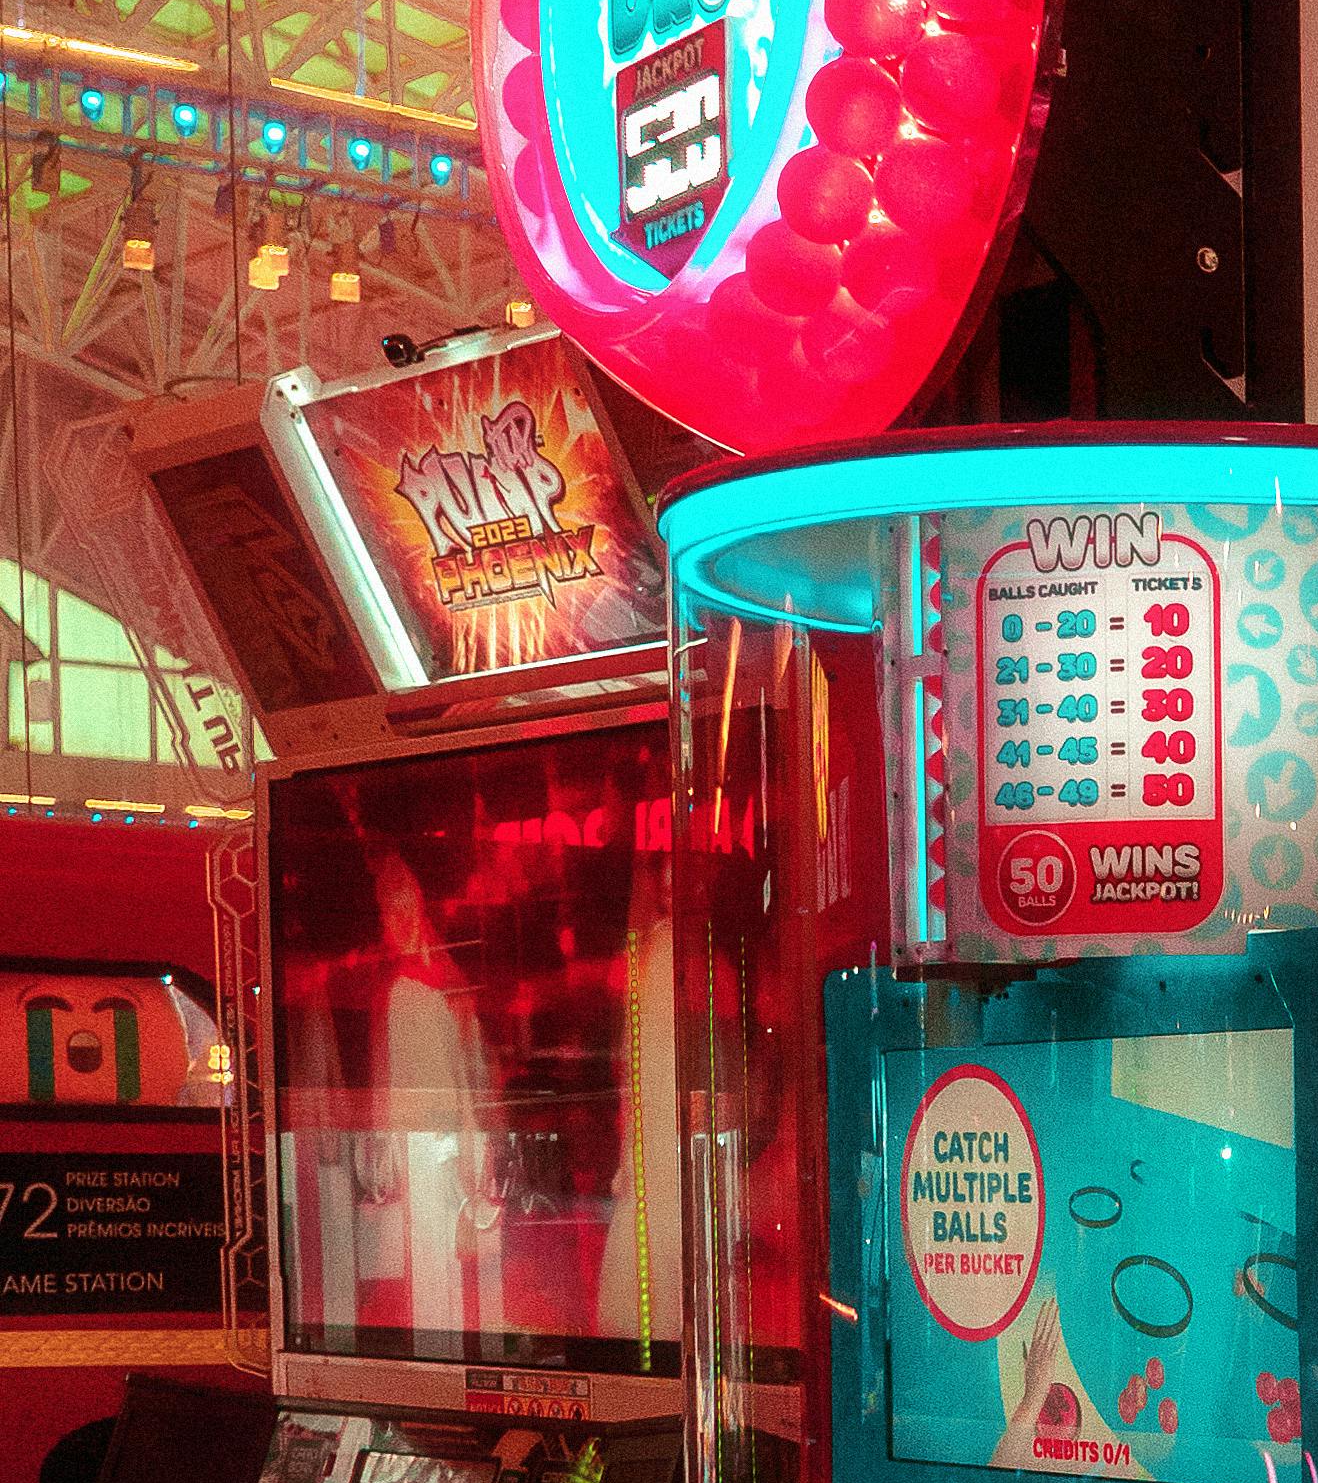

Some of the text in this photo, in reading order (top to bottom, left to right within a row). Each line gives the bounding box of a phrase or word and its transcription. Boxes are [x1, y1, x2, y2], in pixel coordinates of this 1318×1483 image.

[634, 37, 706, 96] JACKPOT
[645, 199, 705, 250] TICKETS
[394, 445, 566, 557] PUMP
[468, 516, 532, 548] 2023
[1027, 512, 1162, 572] WIN
[432, 525, 604, 609] PHOENIX
[988, 577, 1202, 601] BALLS CAUGHT TICKETS
[1002, 614, 1023, 642] 0
[1057, 610, 1097, 638] 20
[1143, 603, 1189, 637] 10
[995, 657, 1028, 685] 21
[1057, 653, 1097, 681] 30
[1141, 645, 1194, 679] 20
[996, 699, 1028, 726] 31
[1057, 695, 1098, 723] 40
[1141, 688, 1195, 722] 30
[995, 741, 1029, 768] 41
[1058, 737, 1099, 765] 45
[1141, 731, 1195, 764] 40
[994, 782, 1034, 810] 46
[1058, 780, 1099, 807] 49
[1142, 773, 1195, 807] 50
[1010, 856, 1064, 893] 50
[1090, 845, 1200, 879] WINS
[1018, 895, 1056, 908] BALLS
[1092, 882, 1199, 901] JACKPOT!
[933, 1130, 1010, 1163] CATCH
[66, 1172, 180, 1187] PRIZE STATION
[913, 1172, 1033, 1203] MULTIPLE
[67, 1194, 150, 1213] DIVERSÃO
[67, 1221, 142, 1238] PRÊMIOS
[933, 1211, 1007, 1243] BALLS
[924, 1254, 1025, 1275] PER BUCKET
[1, 1270, 164, 1294] AME STATION
[1033, 1438, 1131, 1465] CREDITS 0/1
